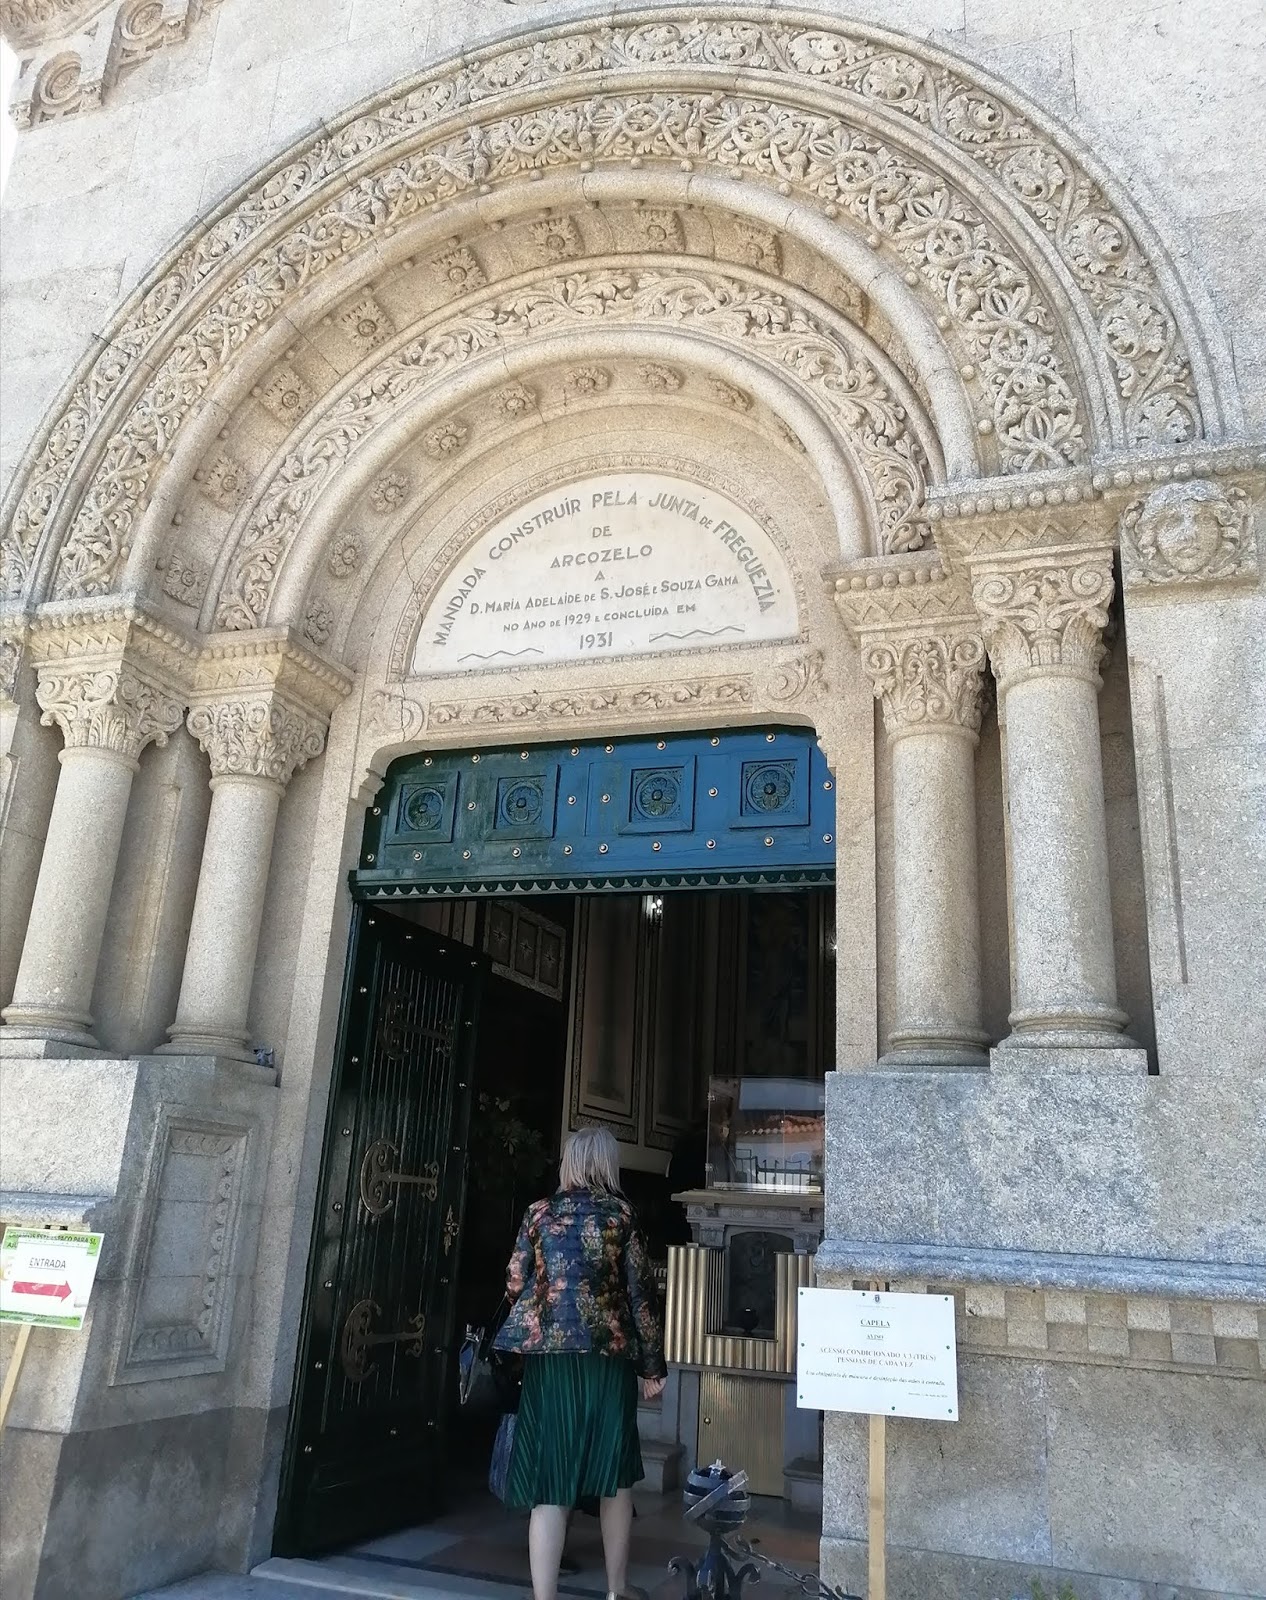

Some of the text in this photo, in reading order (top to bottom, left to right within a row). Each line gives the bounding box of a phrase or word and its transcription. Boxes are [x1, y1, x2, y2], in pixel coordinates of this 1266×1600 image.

[592, 526, 612, 538] DE
[550, 544, 653, 568] ARCOZELO
[433, 567, 486, 645] MANDADA
[592, 490, 638, 508] PELA
[648, 492, 700, 521] JUNTA
[699, 516, 713, 529] DE
[594, 570, 606, 582] A
[470, 602, 483, 615] D.
[584, 593, 596, 602] DE
[600, 587, 613, 600] S.
[614, 582, 650, 598] JOSÉ
[660, 579, 702, 593] SOUZA
[704, 574, 740, 588] GAMA
[503, 622, 519, 632] NO
[522, 620, 546, 630] ANO
[549, 619, 561, 628] DE
[564, 612, 591, 626] 1929
[604, 605, 670, 621] CONCLUÍDA
[676, 603, 697, 614] EM
[579, 632, 614, 650] 1931
[29, 1257, 66, 1269] ENTRADA
[860, 1318, 890, 1327] CAPELA
[846, 1348, 901, 1358] CONDICIONADO
[837, 1356, 867, 1364] PESSOAS
